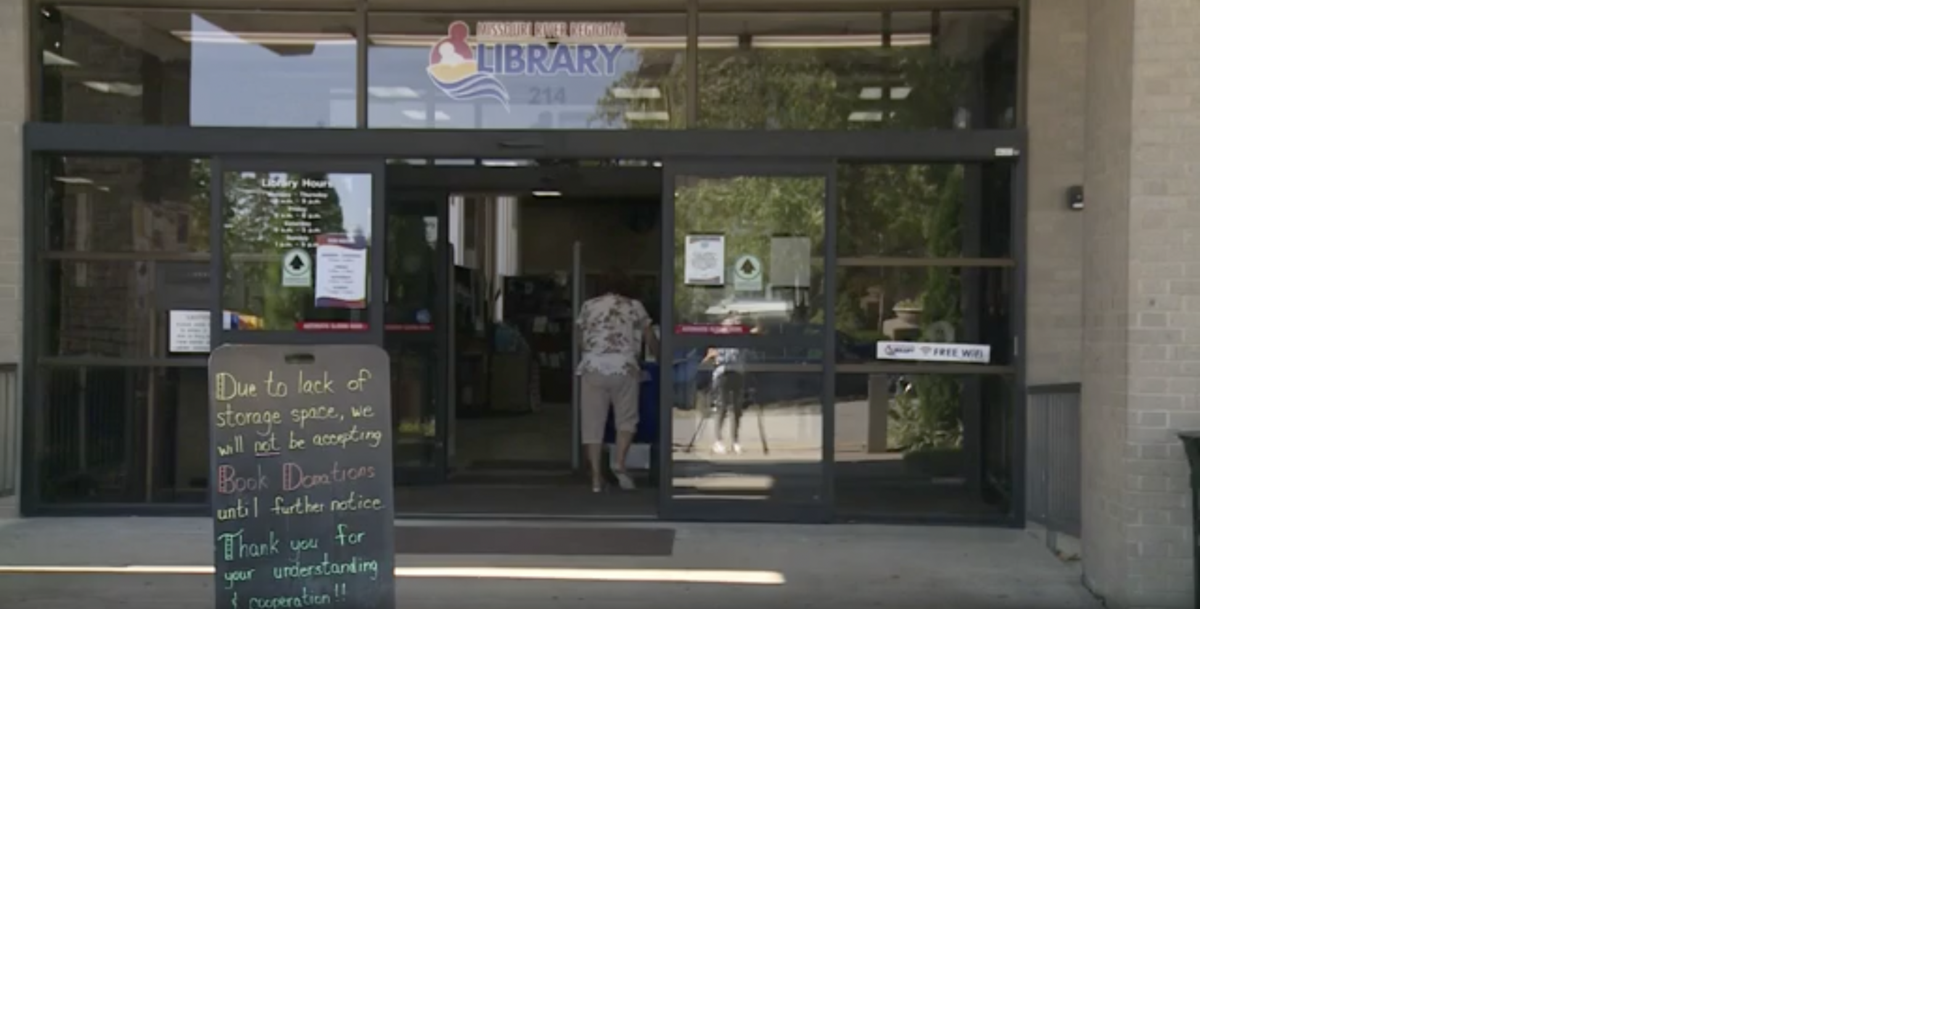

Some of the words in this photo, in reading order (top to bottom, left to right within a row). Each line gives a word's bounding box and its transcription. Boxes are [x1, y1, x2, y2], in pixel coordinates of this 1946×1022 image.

[475, 20, 533, 37] MISSOURI
[534, 20, 567, 37] RIVER
[569, 21, 626, 37] REGIONAL
[477, 43, 624, 75] LIBRARY
[528, 86, 566, 105] 214
[262, 178, 299, 190] Library
[302, 178, 332, 189] Hours
[933, 347, 958, 357] FREE
[215, 372, 258, 401] Due
[264, 370, 288, 397] to
[297, 369, 335, 394] lack
[346, 368, 373, 392] of
[216, 403, 283, 437] storage
[290, 405, 345, 429] space,
[350, 404, 375, 418] we
[217, 434, 244, 457] will
[254, 432, 281, 456] not
[288, 430, 306, 450] be
[312, 424, 383, 449] accepting
[217, 464, 270, 494] Book
[282, 461, 376, 491] Donations
[216, 496, 259, 520] until
[270, 496, 325, 516] further
[217, 528, 281, 561] Thank
[288, 537, 319, 563] you
[334, 523, 366, 546] for
[223, 568, 256, 590] your
[272, 552, 379, 581] understanding
